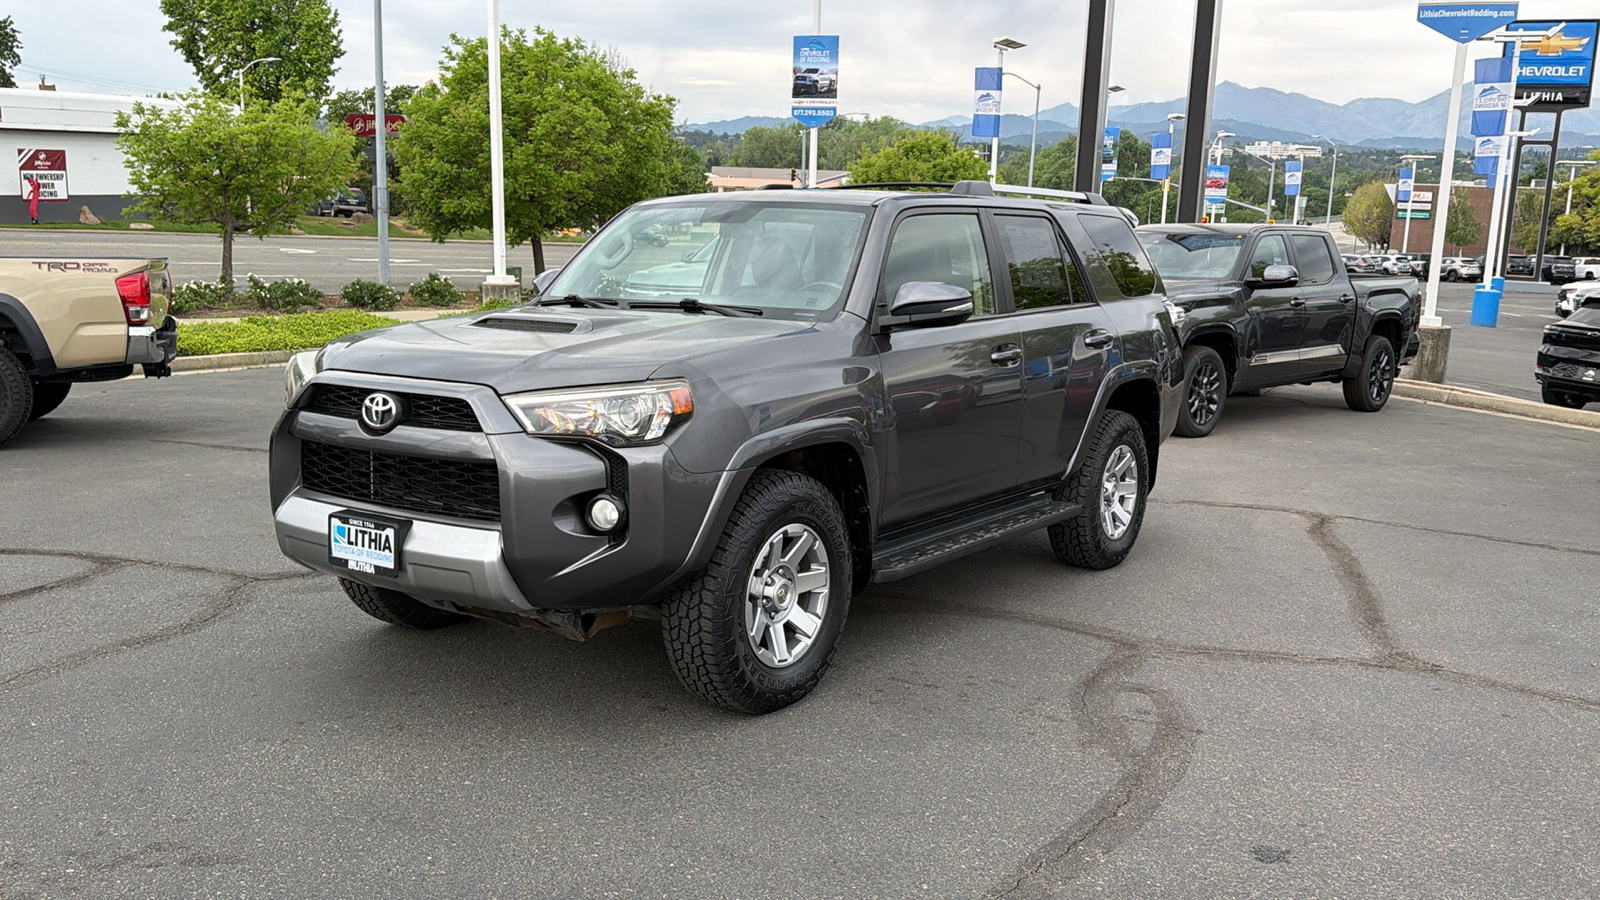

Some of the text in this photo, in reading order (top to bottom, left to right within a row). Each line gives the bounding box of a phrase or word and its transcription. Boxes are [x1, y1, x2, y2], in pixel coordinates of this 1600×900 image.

[1420, 9, 1515, 18] LithiaChevroletRedding.com
[1516, 66, 1586, 77] HEVROLET
[793, 109, 834, 117] 877.293.5503
[32, 262, 80, 272] TRD
[349, 518, 363, 527] SINCE
[347, 527, 393, 554] LITHIA
[334, 544, 393, 563] TOYOTA OF REDDING
[354, 560, 376, 574] LITHIA
